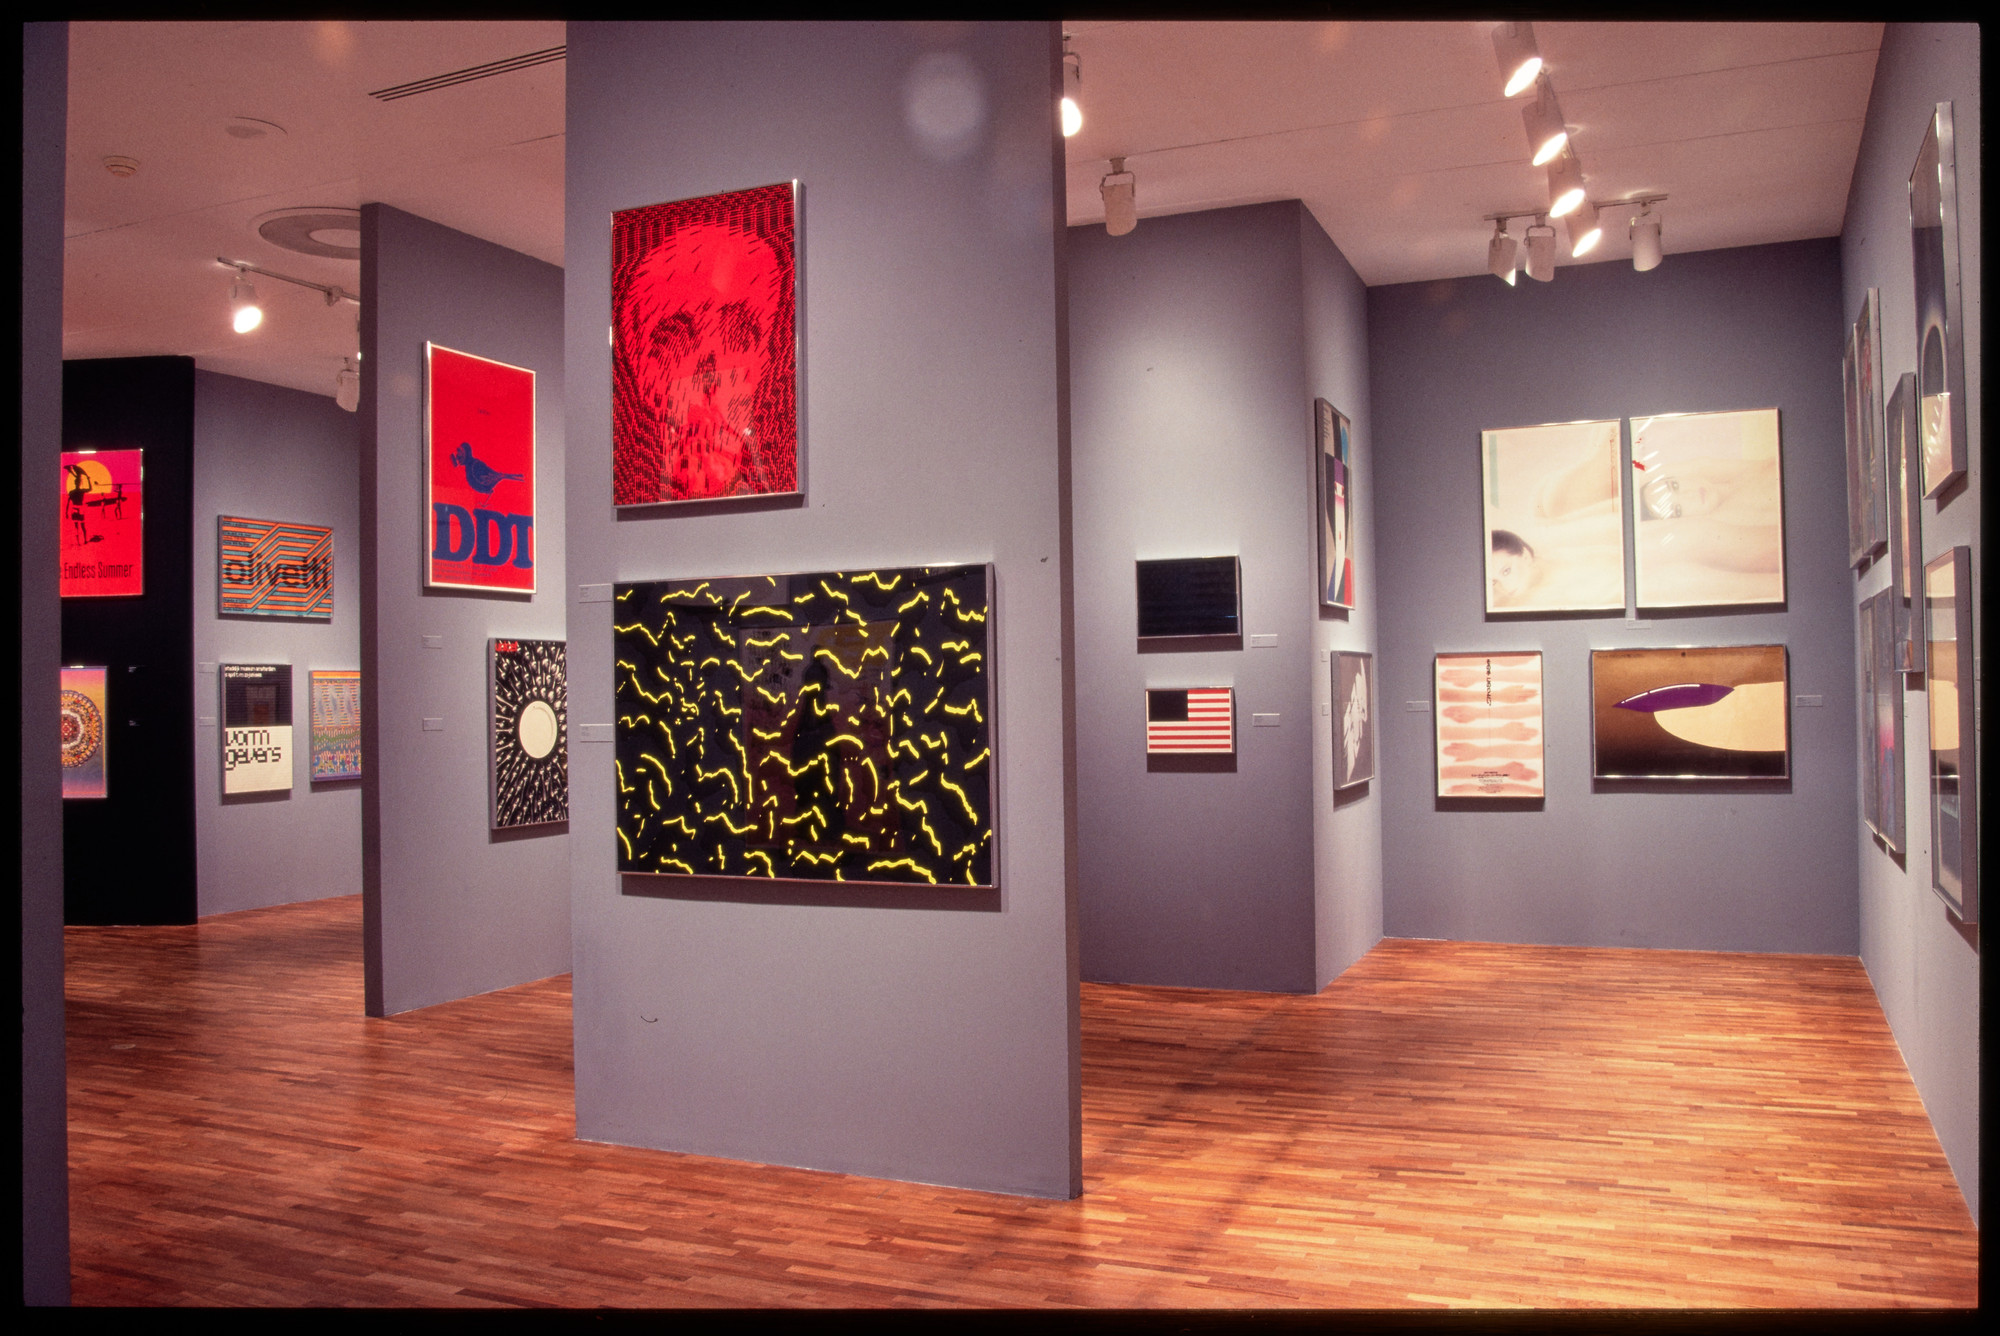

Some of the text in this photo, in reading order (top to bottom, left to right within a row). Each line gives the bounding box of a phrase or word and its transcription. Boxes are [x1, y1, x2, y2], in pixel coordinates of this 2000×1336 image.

[432, 502, 534, 569] DDT
[64, 561, 134, 579] Endless Summer
[225, 747, 282, 771] gevers
